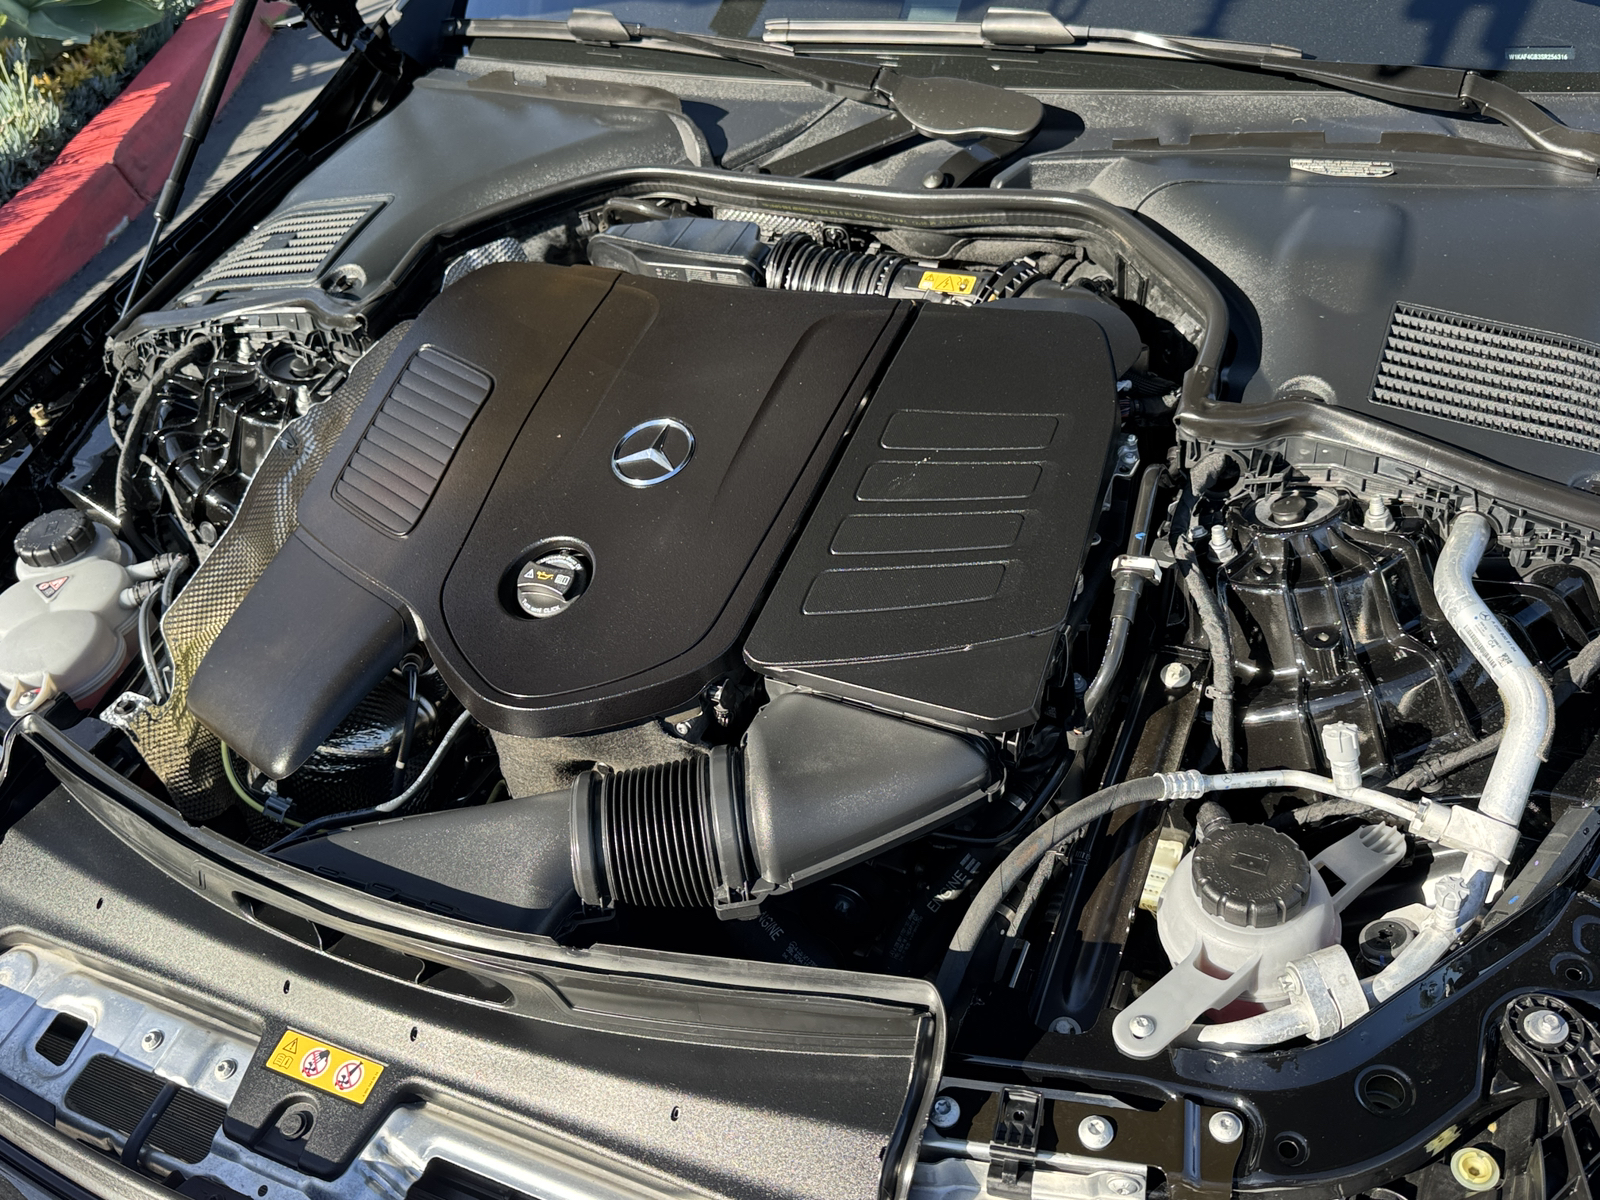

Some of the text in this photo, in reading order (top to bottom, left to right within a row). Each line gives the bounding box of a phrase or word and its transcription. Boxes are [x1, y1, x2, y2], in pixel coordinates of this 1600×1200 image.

[543, 604, 561, 614] CLICK
[926, 869, 968, 914] ENGINE
[758, 910, 785, 942] NGINE
